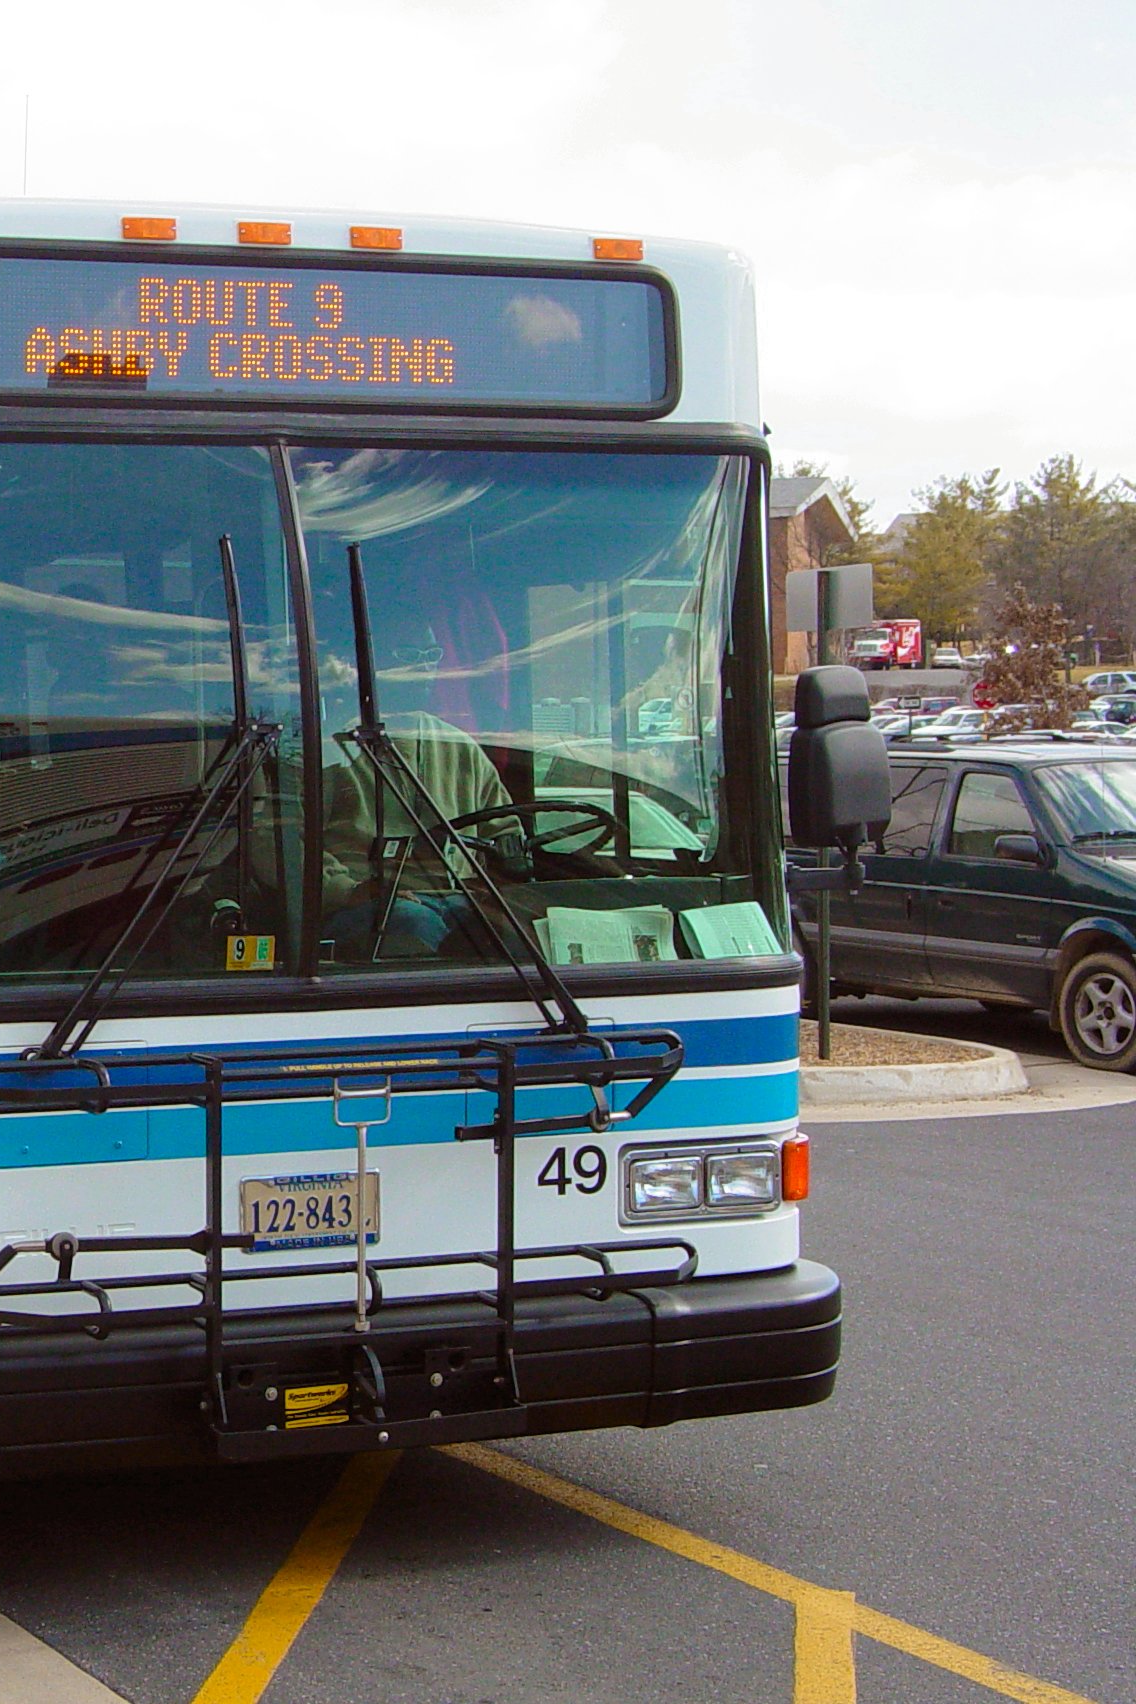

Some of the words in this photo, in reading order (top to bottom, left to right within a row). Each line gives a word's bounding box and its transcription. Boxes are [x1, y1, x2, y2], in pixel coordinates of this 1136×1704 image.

[139, 277, 294, 327] ROUTE
[315, 283, 343, 329] 9
[25, 326, 188, 377] ASHBY
[209, 332, 455, 383] CROSSING
[236, 938, 246, 961] 9
[537, 1144, 608, 1196] 49
[251, 1193, 353, 1233] 122-843
